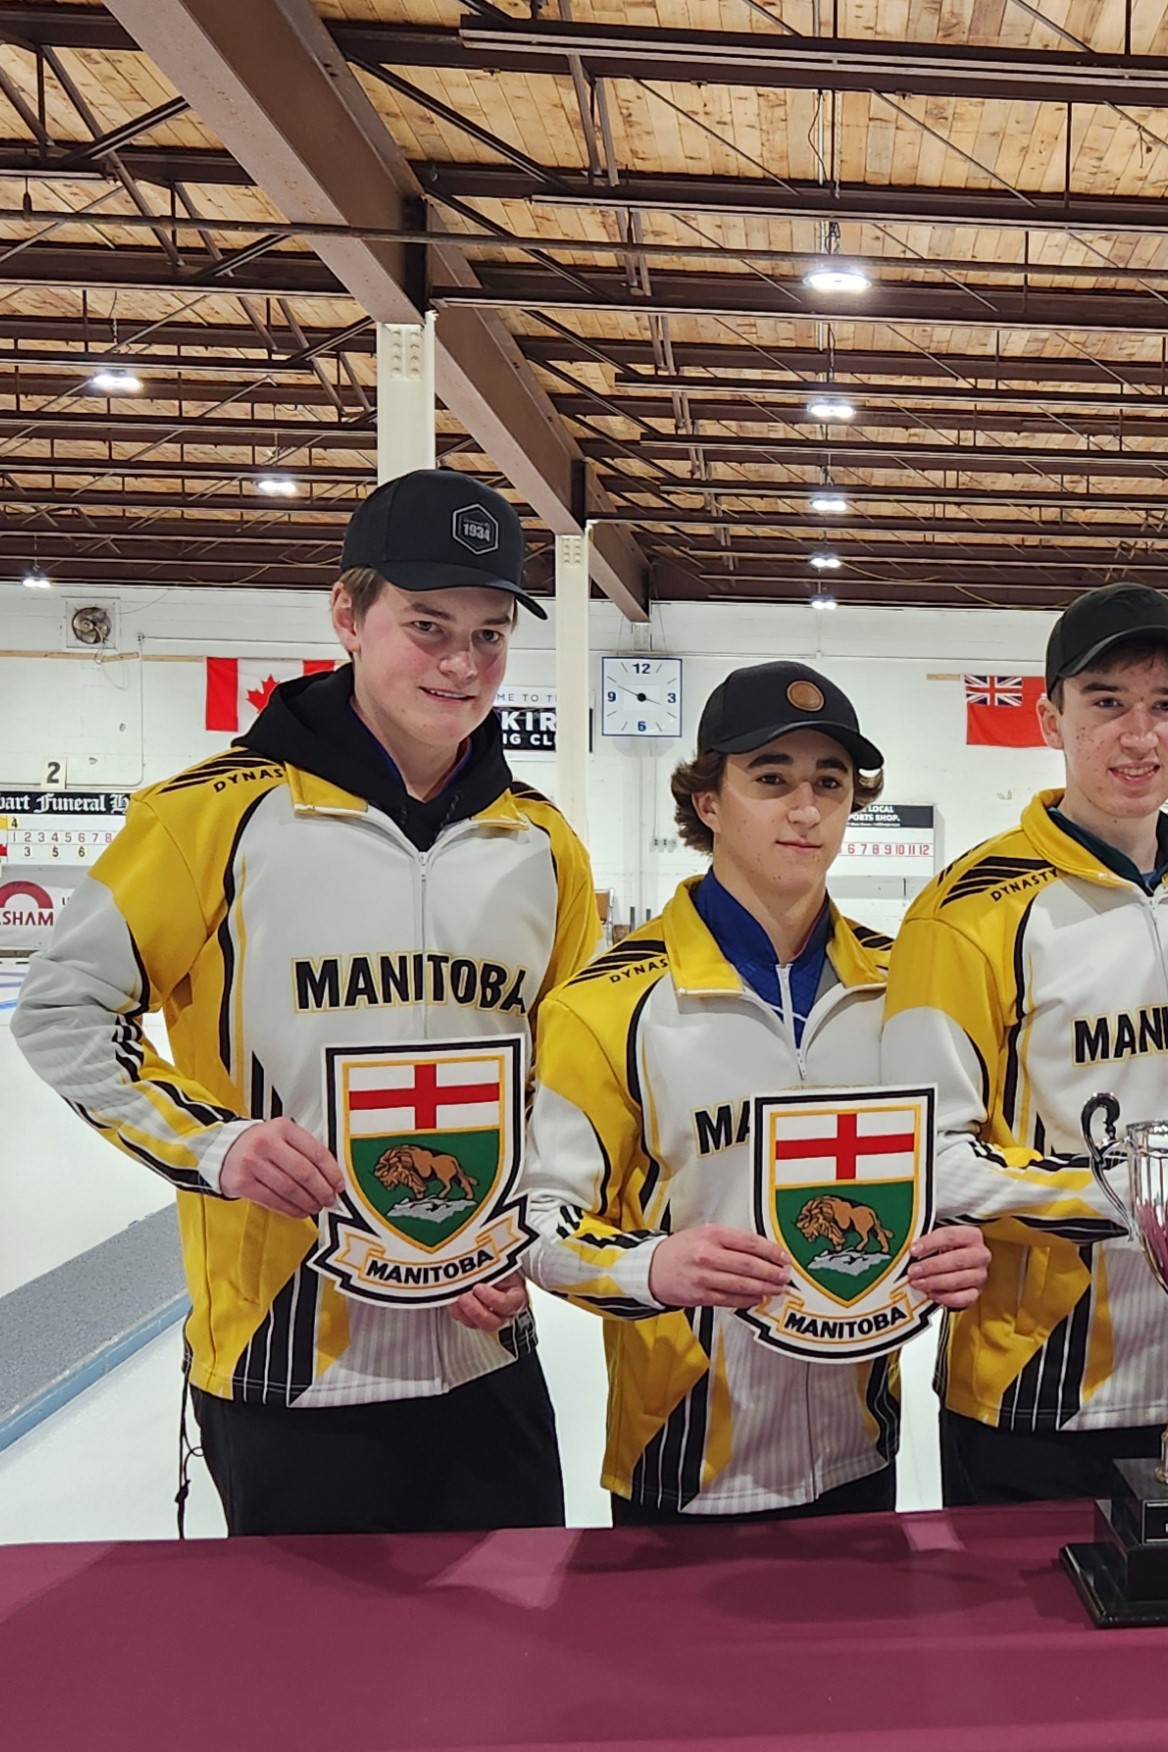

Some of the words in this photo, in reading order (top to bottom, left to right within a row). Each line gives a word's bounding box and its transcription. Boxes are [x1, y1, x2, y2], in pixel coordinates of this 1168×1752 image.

[463, 523, 490, 541] 1934
[633, 663, 650, 674] 12
[523, 694, 539, 702] TO
[547, 694, 557, 703] T
[607, 691, 616, 702] 9
[667, 693, 676, 703] 3
[638, 721, 646, 731] 6
[530, 734, 556, 746] CL
[47, 762, 61, 784] 2
[33, 793, 106, 814] Funeral
[868, 805, 895, 814] LOCAL
[11, 817, 18, 829] 4
[875, 814, 901, 822] SHOP.
[24, 832, 32, 843] 2
[38, 832, 45, 843] 3
[51, 832, 59, 843] 4
[65, 832, 72, 843] 5
[78, 832, 86, 843] 6
[91, 833, 99, 843] 7
[105, 833, 112, 843] 8
[24, 847, 31, 857] 3
[52, 846, 59, 857] 5
[78, 846, 86, 857] 6
[847, 843, 856, 854] 6
[861, 844, 868, 855] 7
[872, 844, 880, 855] 8
[884, 844, 892, 855] 9
[895, 844, 905, 855] 10
[908, 845, 916, 855] 11
[919, 844, 930, 856] 12
[990, 867, 1058, 902] DYNASTY
[0, 911, 54, 926] SHAM
[293, 953, 527, 1012] MANITOBA
[365, 1248, 494, 1285] MANITOBA
[784, 1306, 908, 1340] MANITOBA
